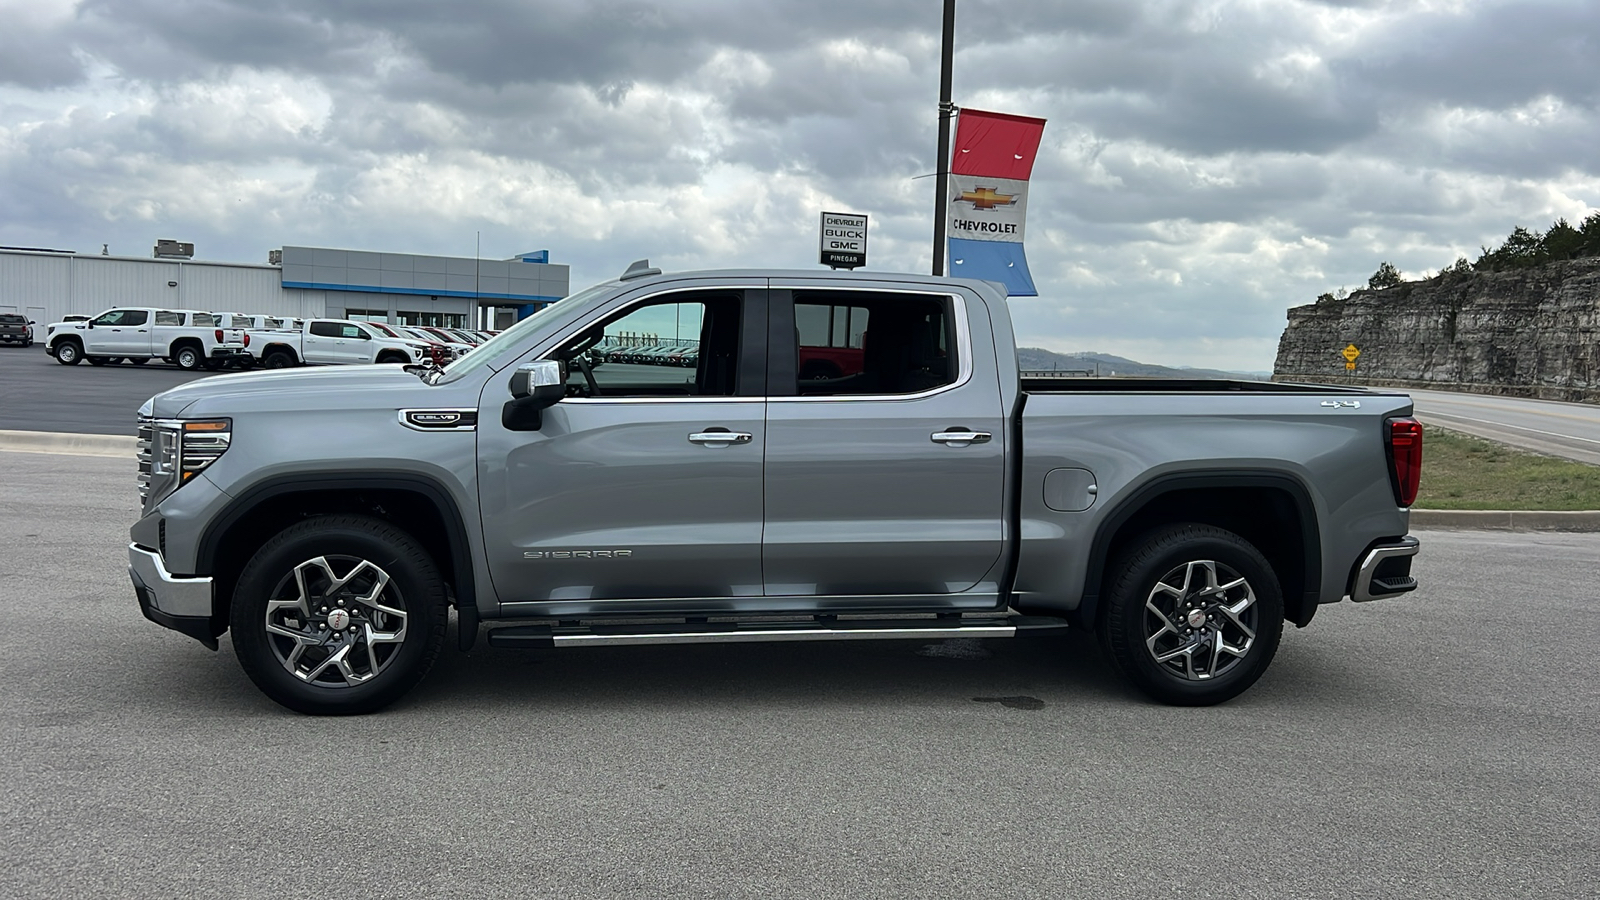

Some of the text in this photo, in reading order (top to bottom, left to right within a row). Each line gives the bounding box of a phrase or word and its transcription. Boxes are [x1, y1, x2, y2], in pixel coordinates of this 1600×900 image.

[826, 218, 864, 226] CHEVROLET
[825, 229, 863, 238] BUICK
[830, 241, 858, 249] GMC
[523, 550, 632, 558] SIERRA
